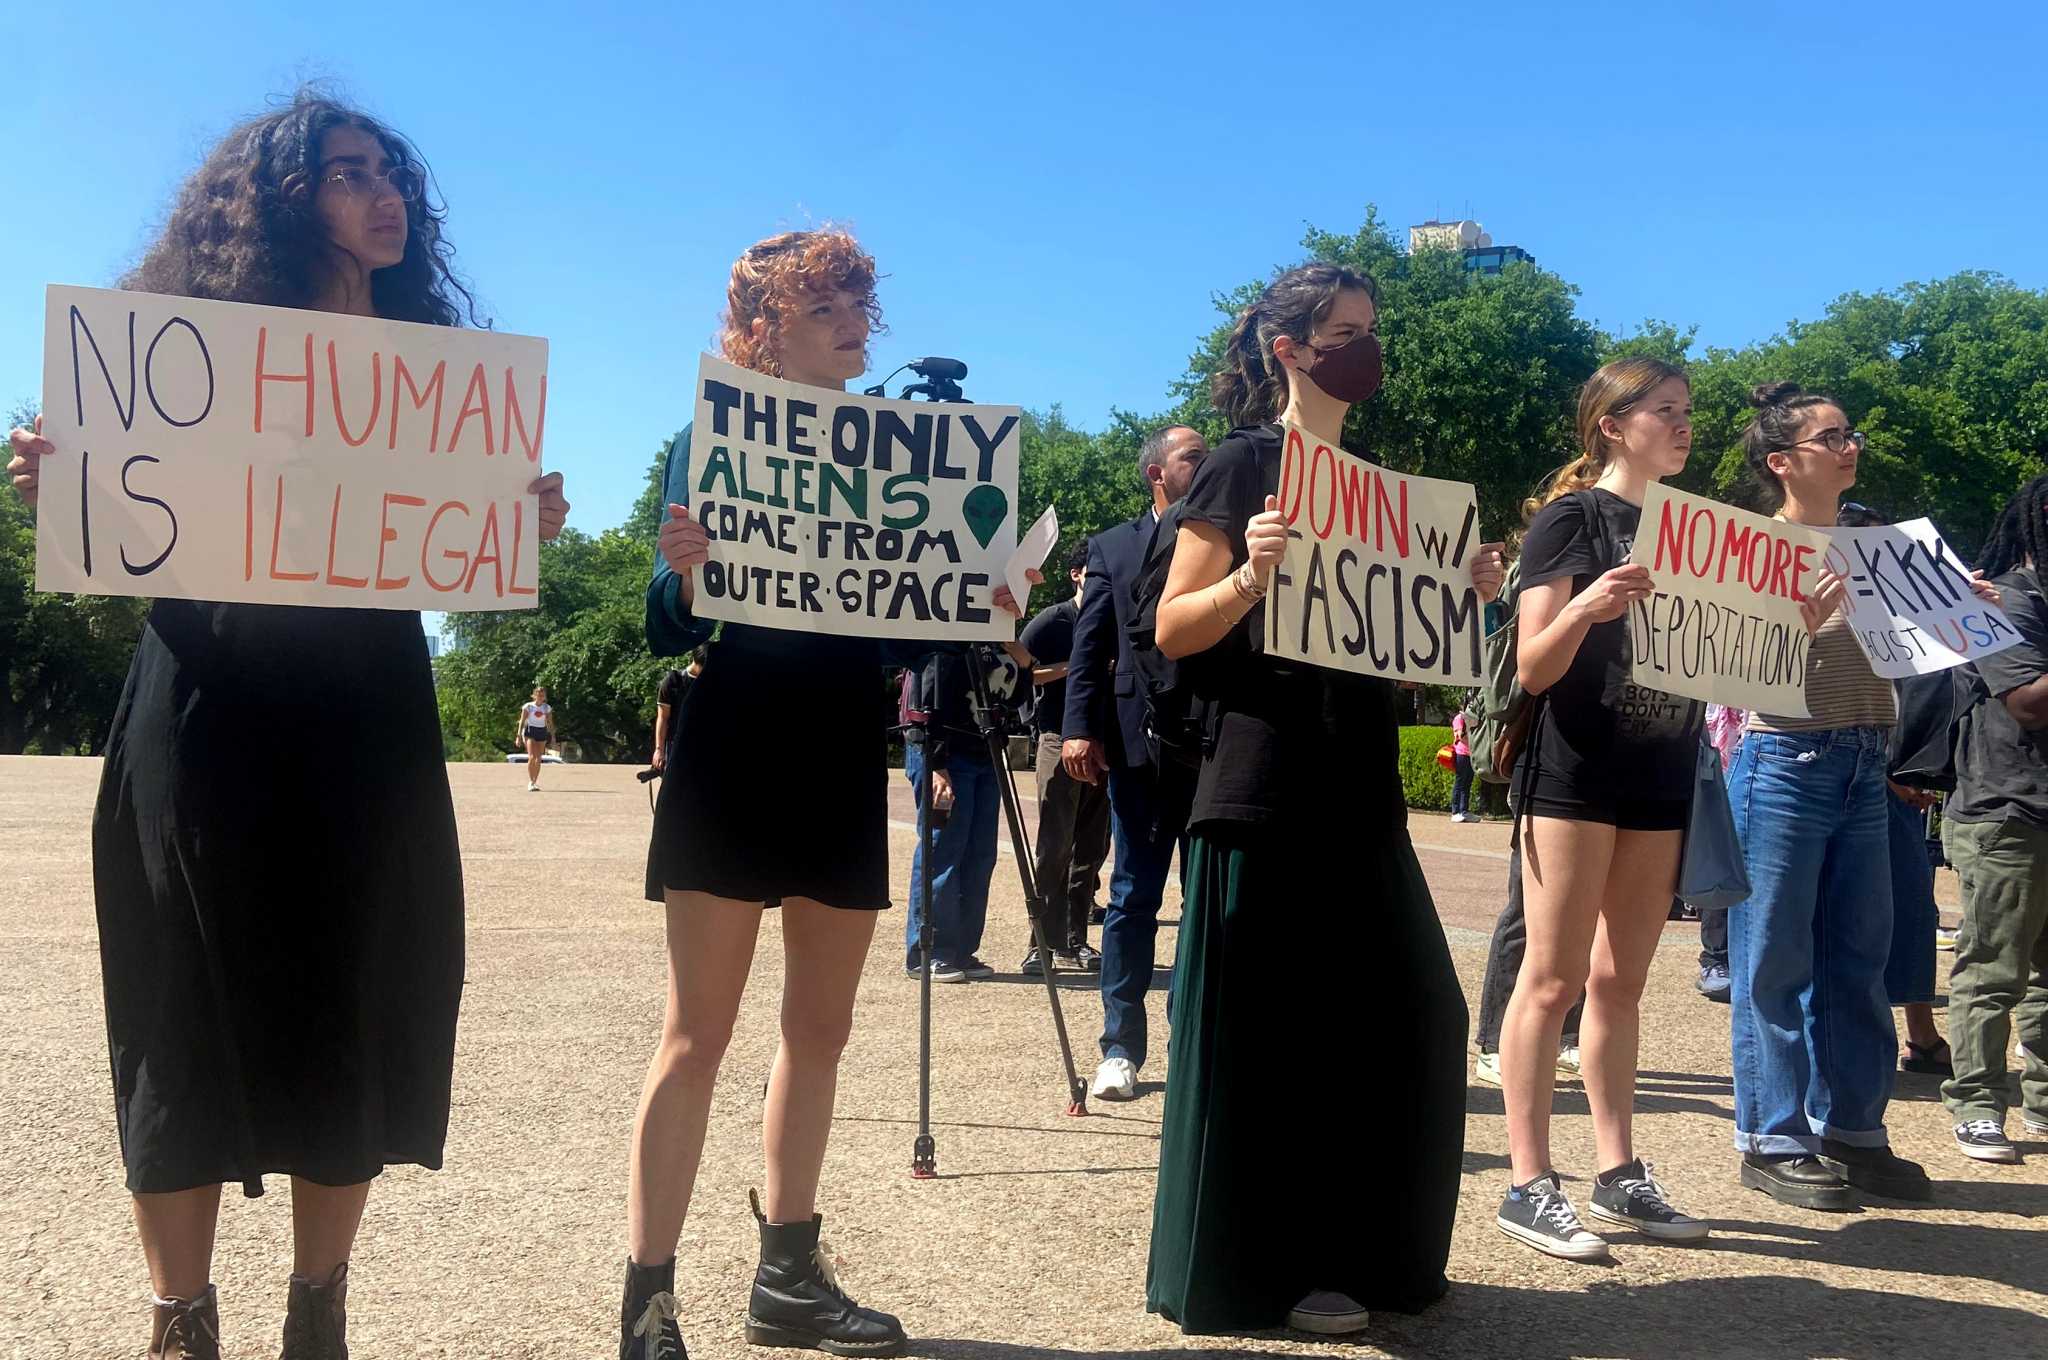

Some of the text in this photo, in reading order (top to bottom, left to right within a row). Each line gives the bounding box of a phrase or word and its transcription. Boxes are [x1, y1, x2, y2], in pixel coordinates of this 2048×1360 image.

[70, 304, 547, 463] NO HUMAN
[81, 451, 536, 597] IS ILLEGAL
[698, 446, 930, 530] ALIENS
[1279, 428, 1409, 558] DOWN
[1654, 499, 1817, 603] NO MORE
[1272, 529, 1482, 678] FASCISM
[1632, 592, 1809, 688] DEPORTATIONS
[1933, 610, 2015, 653] USA
[1622, 702, 1681, 720] DON'T
